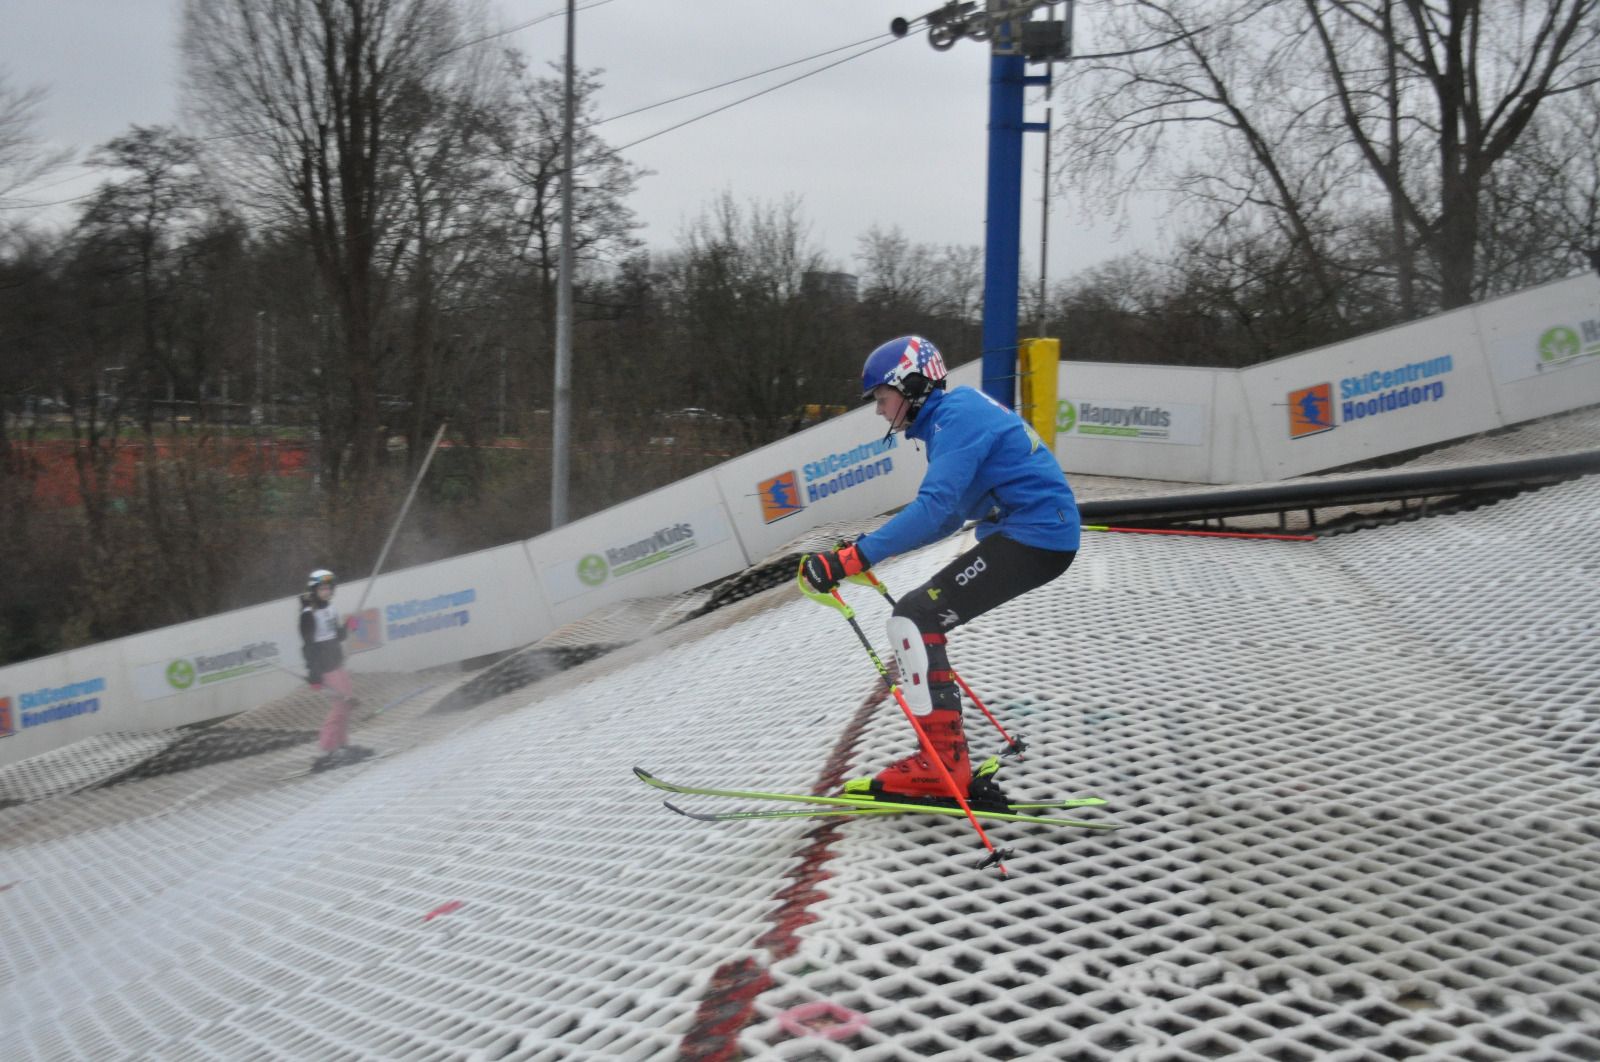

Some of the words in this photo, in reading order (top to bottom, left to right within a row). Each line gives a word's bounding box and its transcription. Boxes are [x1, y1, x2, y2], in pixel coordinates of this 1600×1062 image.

[1340, 355, 1453, 399] SkiCentrum
[1080, 403, 1171, 427] HappyKids
[1343, 381, 1444, 422] Hoofddorp
[803, 434, 898, 482] SkiCentrum
[807, 457, 893, 503] Hoofddorp
[605, 523, 694, 566] HappyKids
